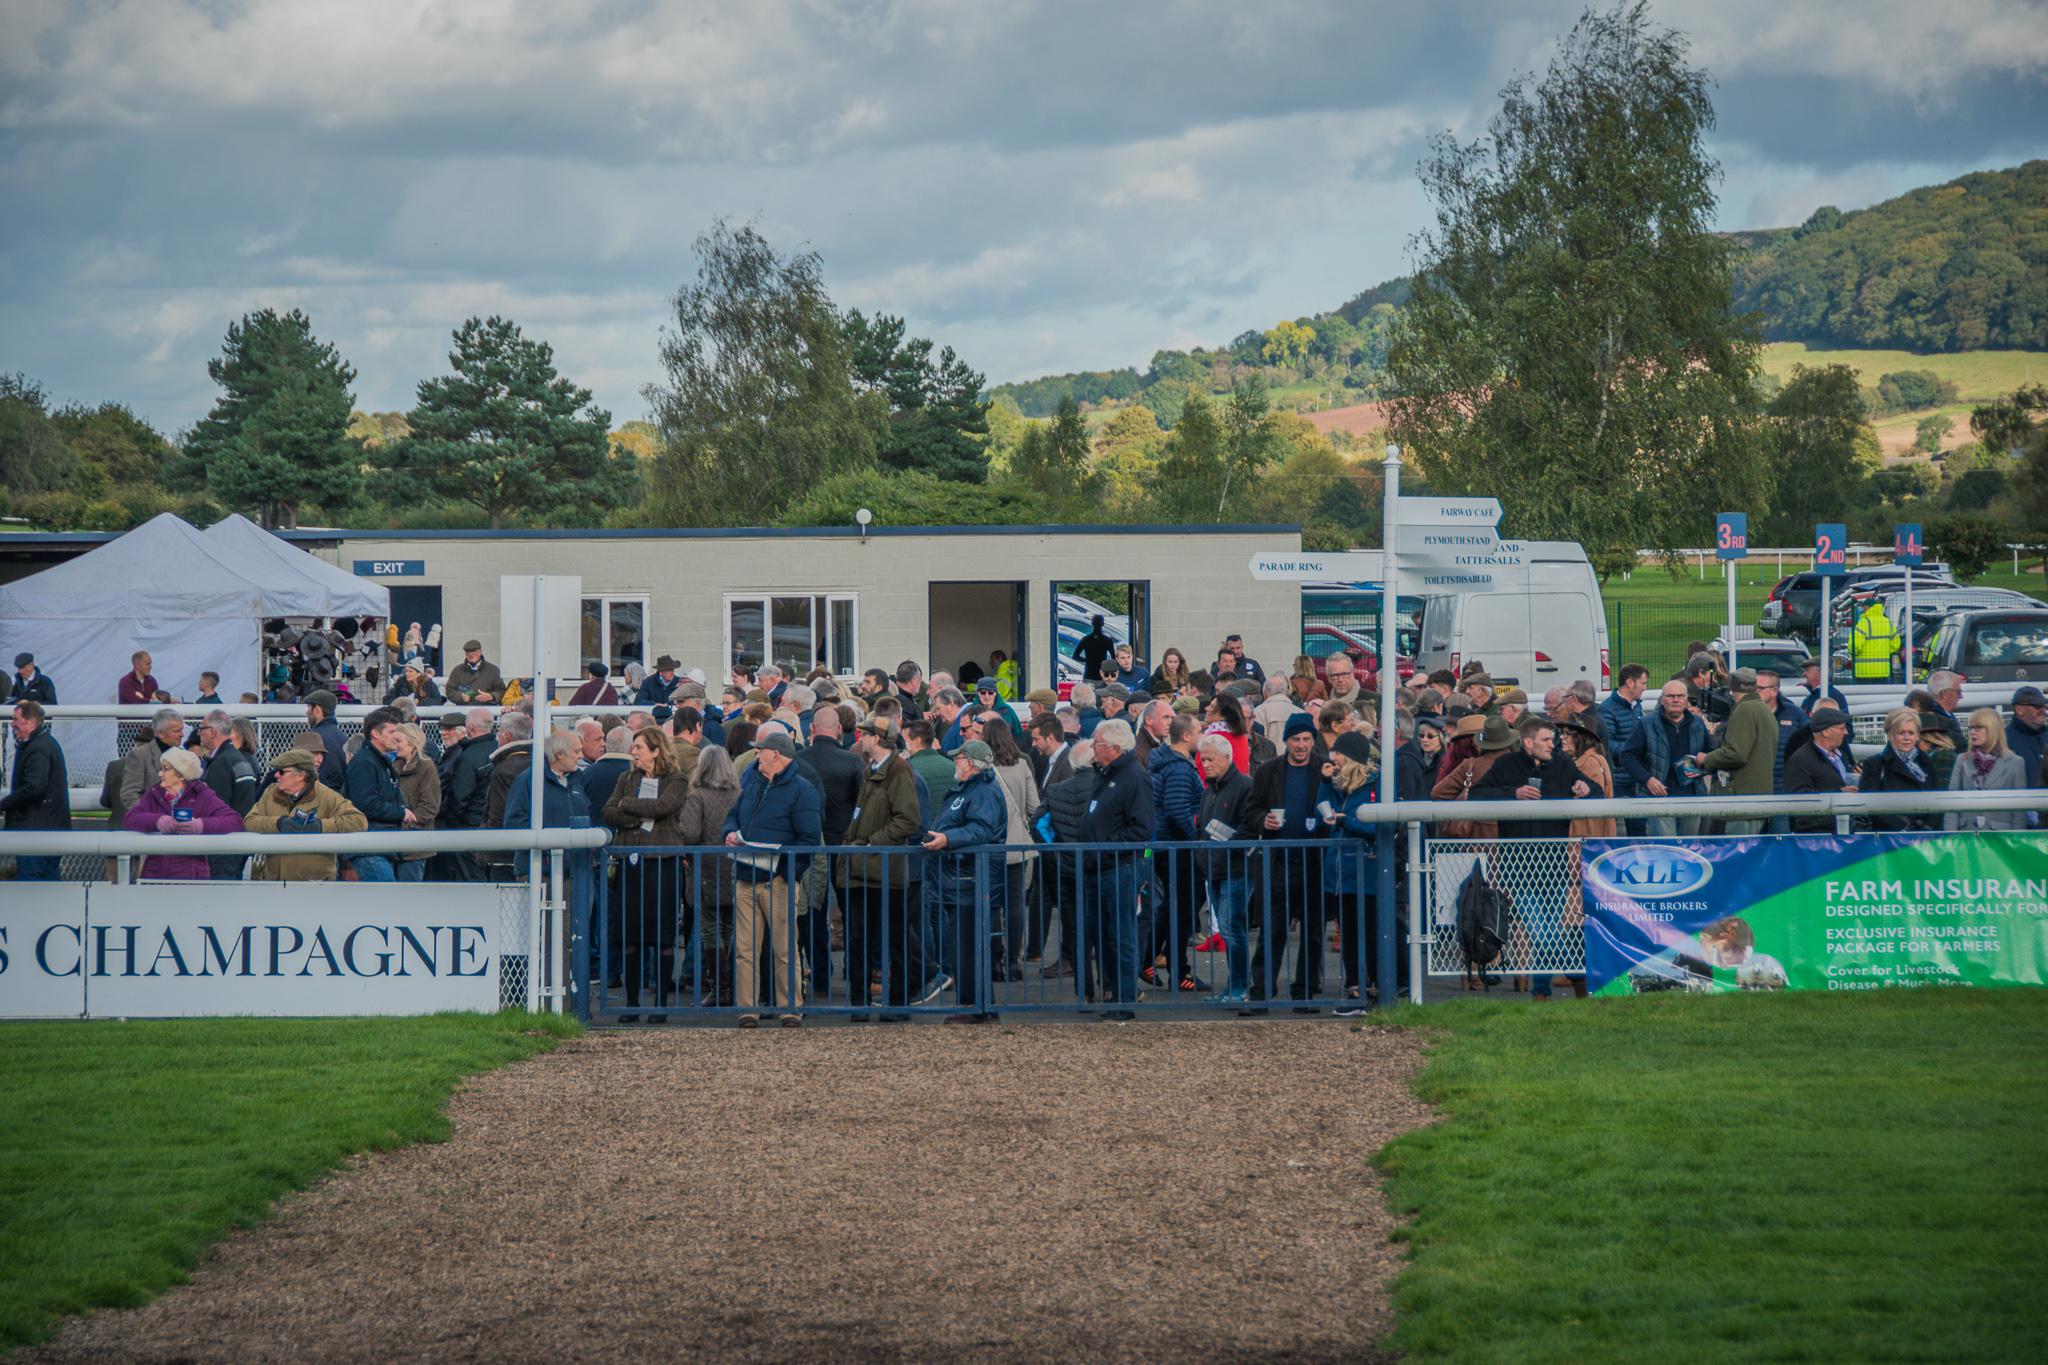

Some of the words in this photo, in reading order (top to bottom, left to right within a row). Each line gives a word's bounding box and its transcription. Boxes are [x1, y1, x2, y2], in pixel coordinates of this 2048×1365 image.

[1441, 508, 1473, 516] FAIRWAY
[1424, 536, 1465, 545] PLYMOUTH
[1466, 537, 1490, 545] STAND
[1718, 523, 1745, 549] 3RD
[1817, 535, 1845, 564] 2ND
[1259, 562, 1297, 571] PARADE
[1299, 562, 1323, 571] RING
[1455, 556, 1521, 565] TATTERSALLS
[373, 562, 404, 574] EXIT
[1612, 860, 1686, 885] KLF
[1825, 879, 1903, 902] FARM
[1914, 878, 2047, 900] INSURAN
[1595, 901, 1657, 911] INSURANCE
[1659, 901, 1708, 911] BROKERS
[1825, 904, 1903, 917] DESIGNED
[1907, 902, 2013, 916] SPECIFICALLY
[2017, 902, 2048, 914] FOR
[1629, 912, 1674, 922] LIMITED
[1825, 927, 1906, 939] EXCLUSIVE
[1910, 925, 1998, 938] INSURANCE
[35, 923, 489, 977] CHAMPAGNE
[1826, 941, 1895, 955] PACKAGE
[1899, 940, 1929, 953] FOR
[1934, 940, 2001, 952] FARMERS
[1827, 964, 1869, 977] Cover
[1871, 963, 1892, 976] for
[1895, 962, 1960, 976] Livestock
[1827, 979, 1878, 991] Disease
